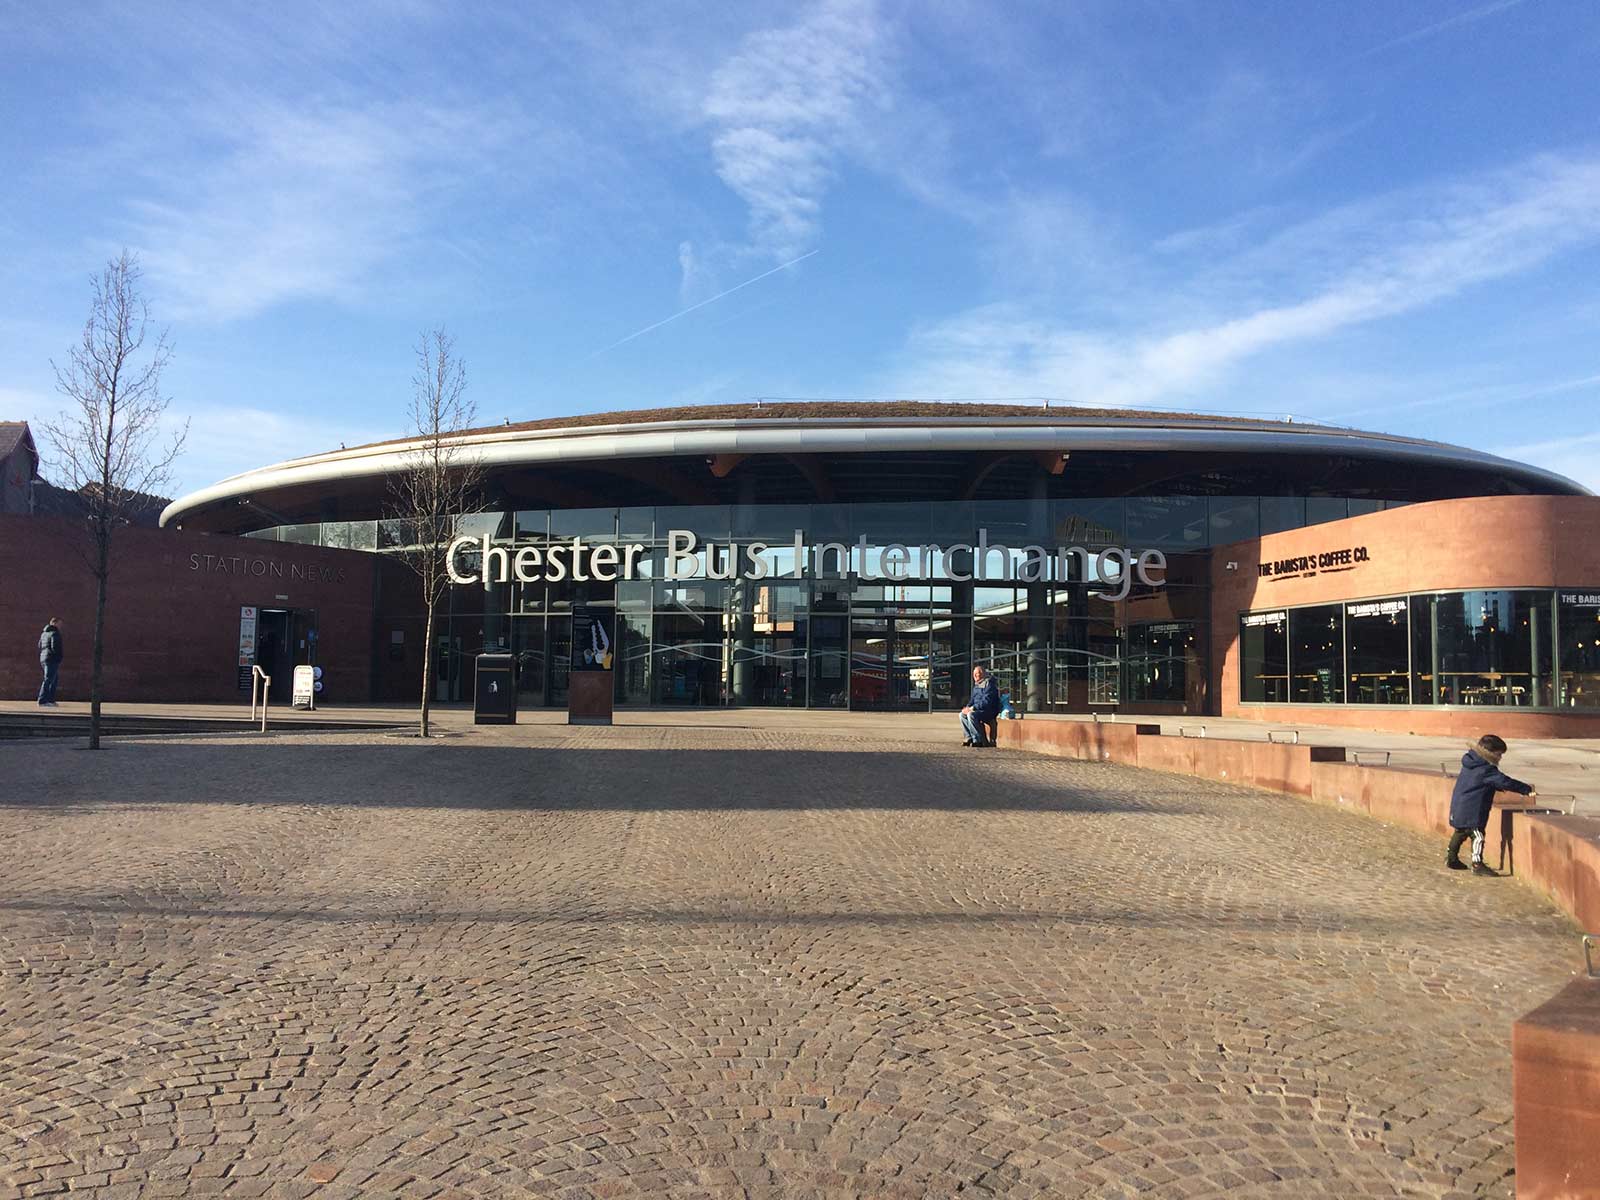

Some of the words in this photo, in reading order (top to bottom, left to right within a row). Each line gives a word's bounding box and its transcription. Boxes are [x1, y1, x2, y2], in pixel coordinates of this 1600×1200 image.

[190, 553, 283, 577] STATION
[291, 563, 345, 584] NEWS
[446, 533, 644, 585] Chester
[666, 529, 769, 581] Bus
[794, 528, 1167, 601] Interchange
[1257, 562, 1272, 577] THE
[1274, 555, 1317, 575] BARISTA'S
[1318, 549, 1352, 568] COFFEE
[1353, 546, 1370, 563] CO.
[1562, 594, 1577, 604] THE
